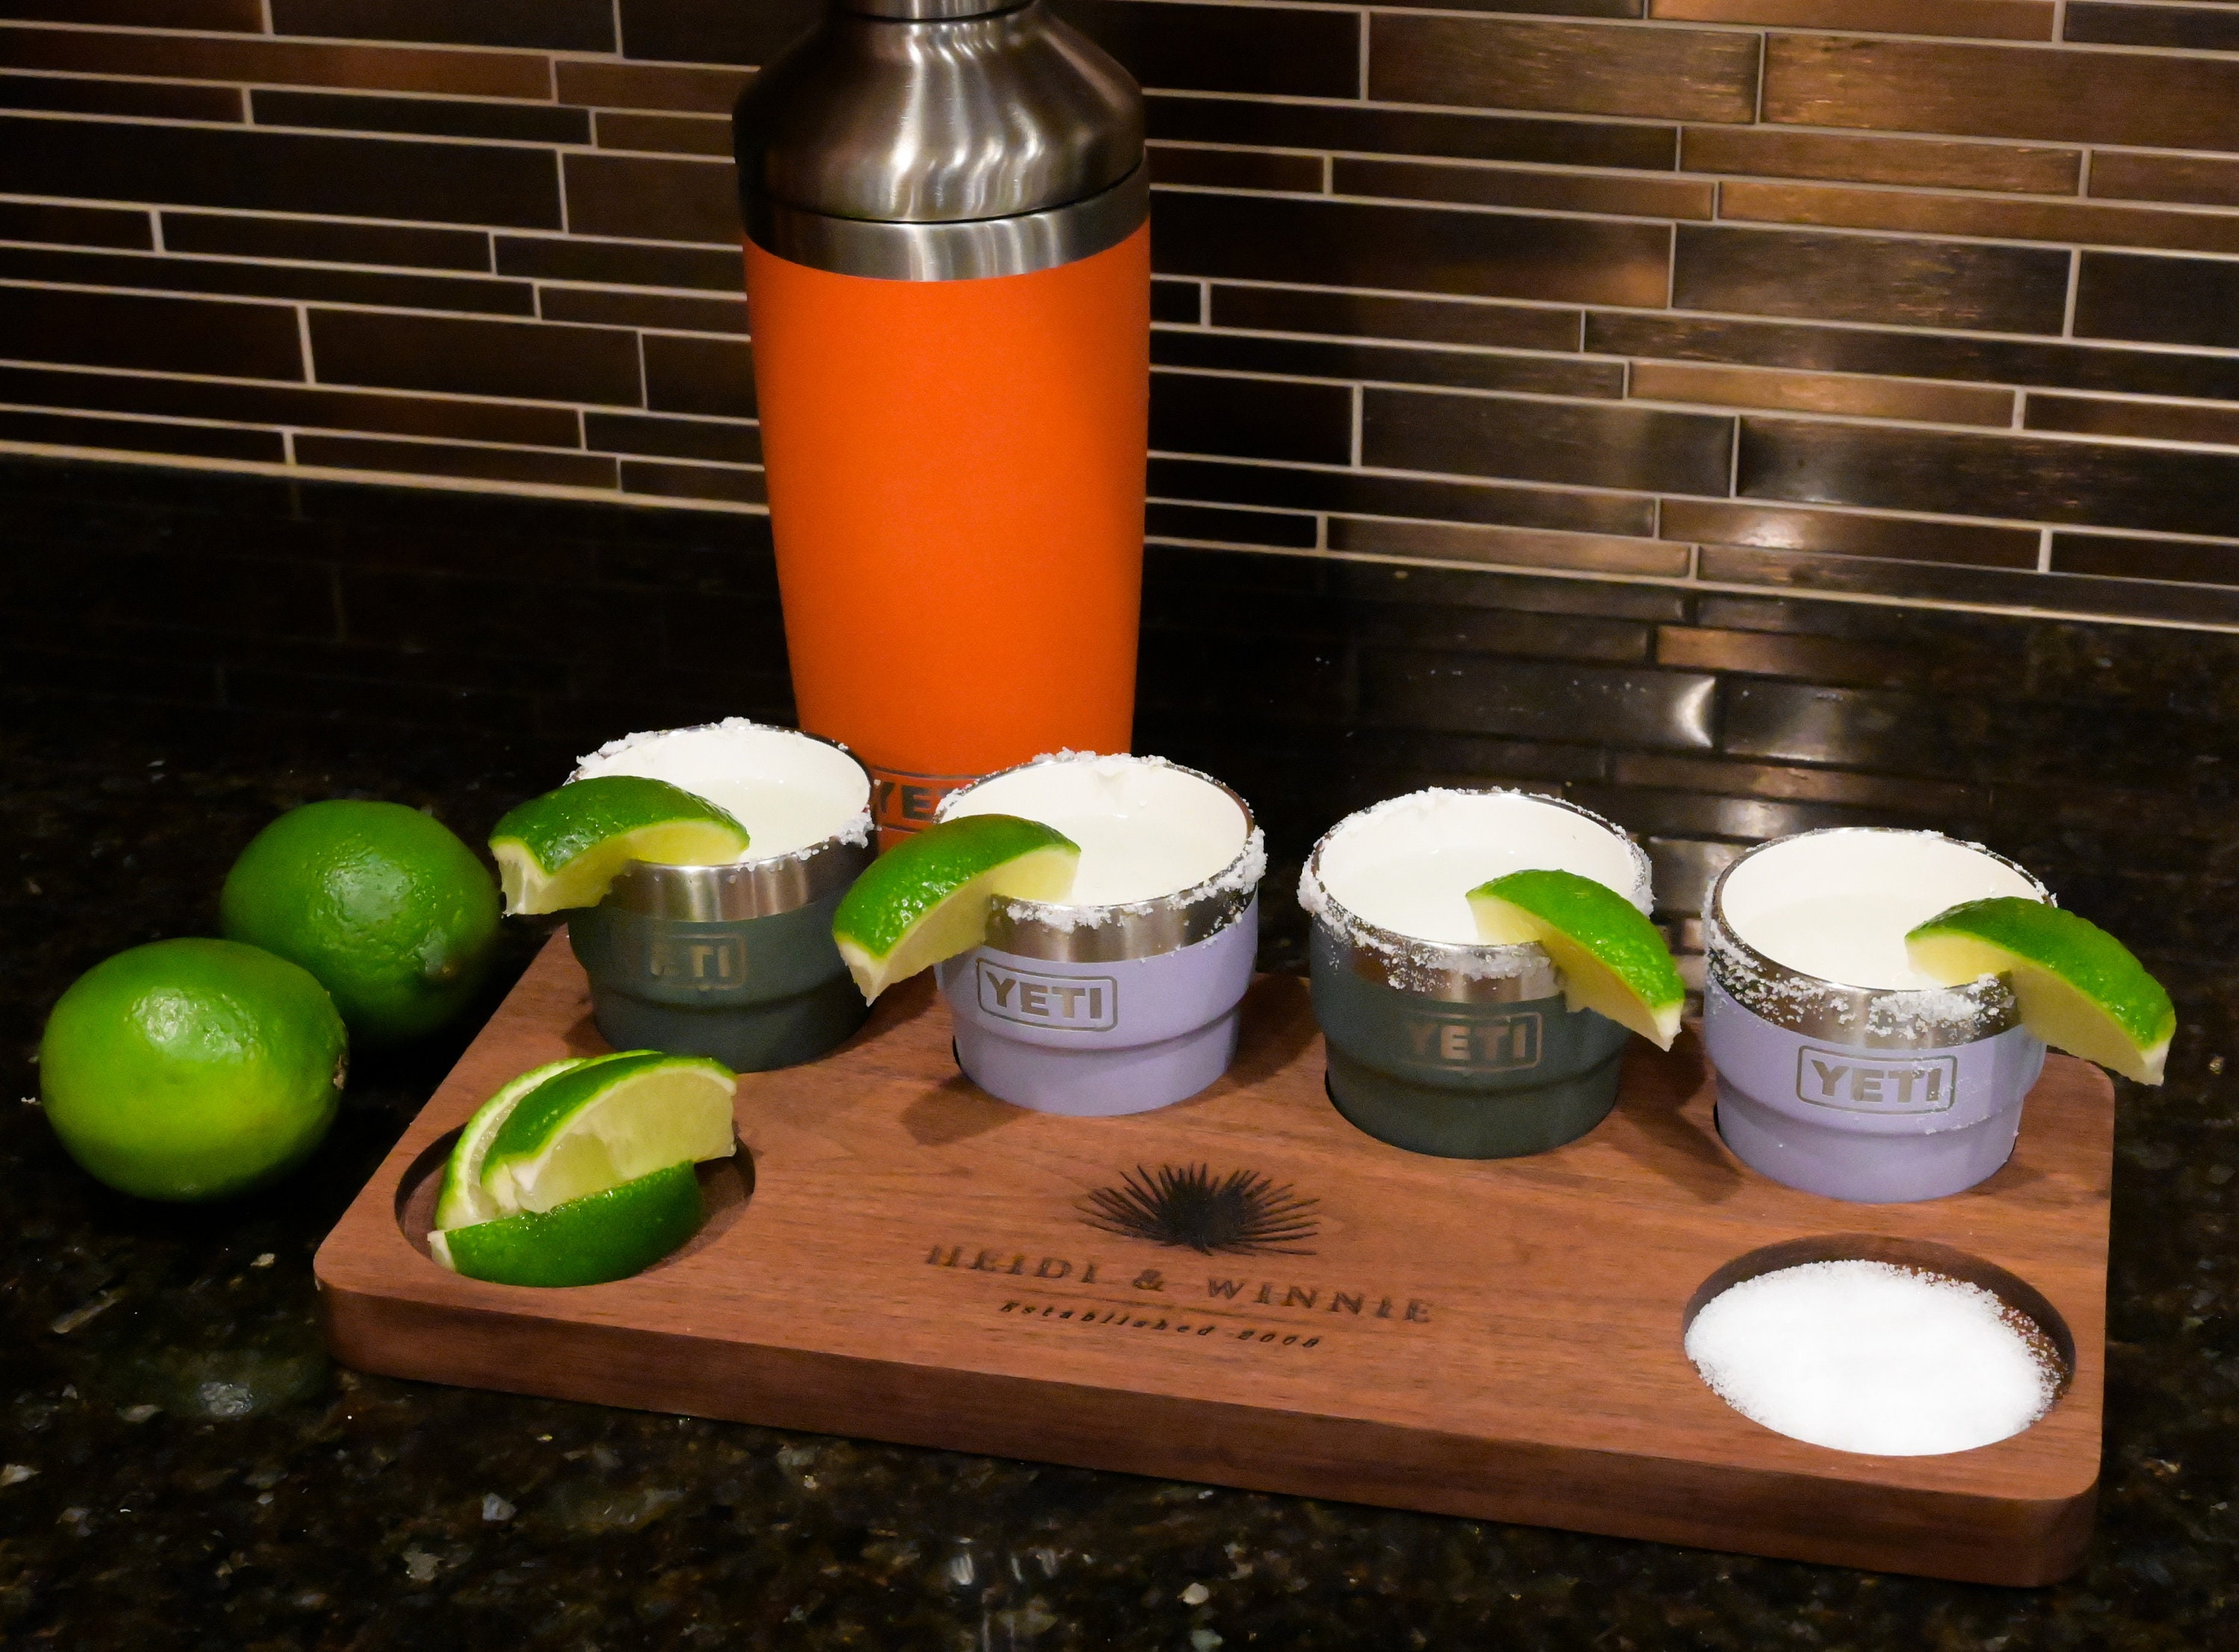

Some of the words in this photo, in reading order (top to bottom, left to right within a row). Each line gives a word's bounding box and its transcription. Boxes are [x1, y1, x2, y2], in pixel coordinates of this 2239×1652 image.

[985, 971, 1102, 1019] YETI
[1407, 1022, 1527, 1060] YETI
[1811, 1060, 1942, 1103] YETI
[925, 1244, 1102, 1283] HEIDI
[1131, 1268, 1164, 1292] &
[1206, 1277, 1434, 1324] WINNIE
